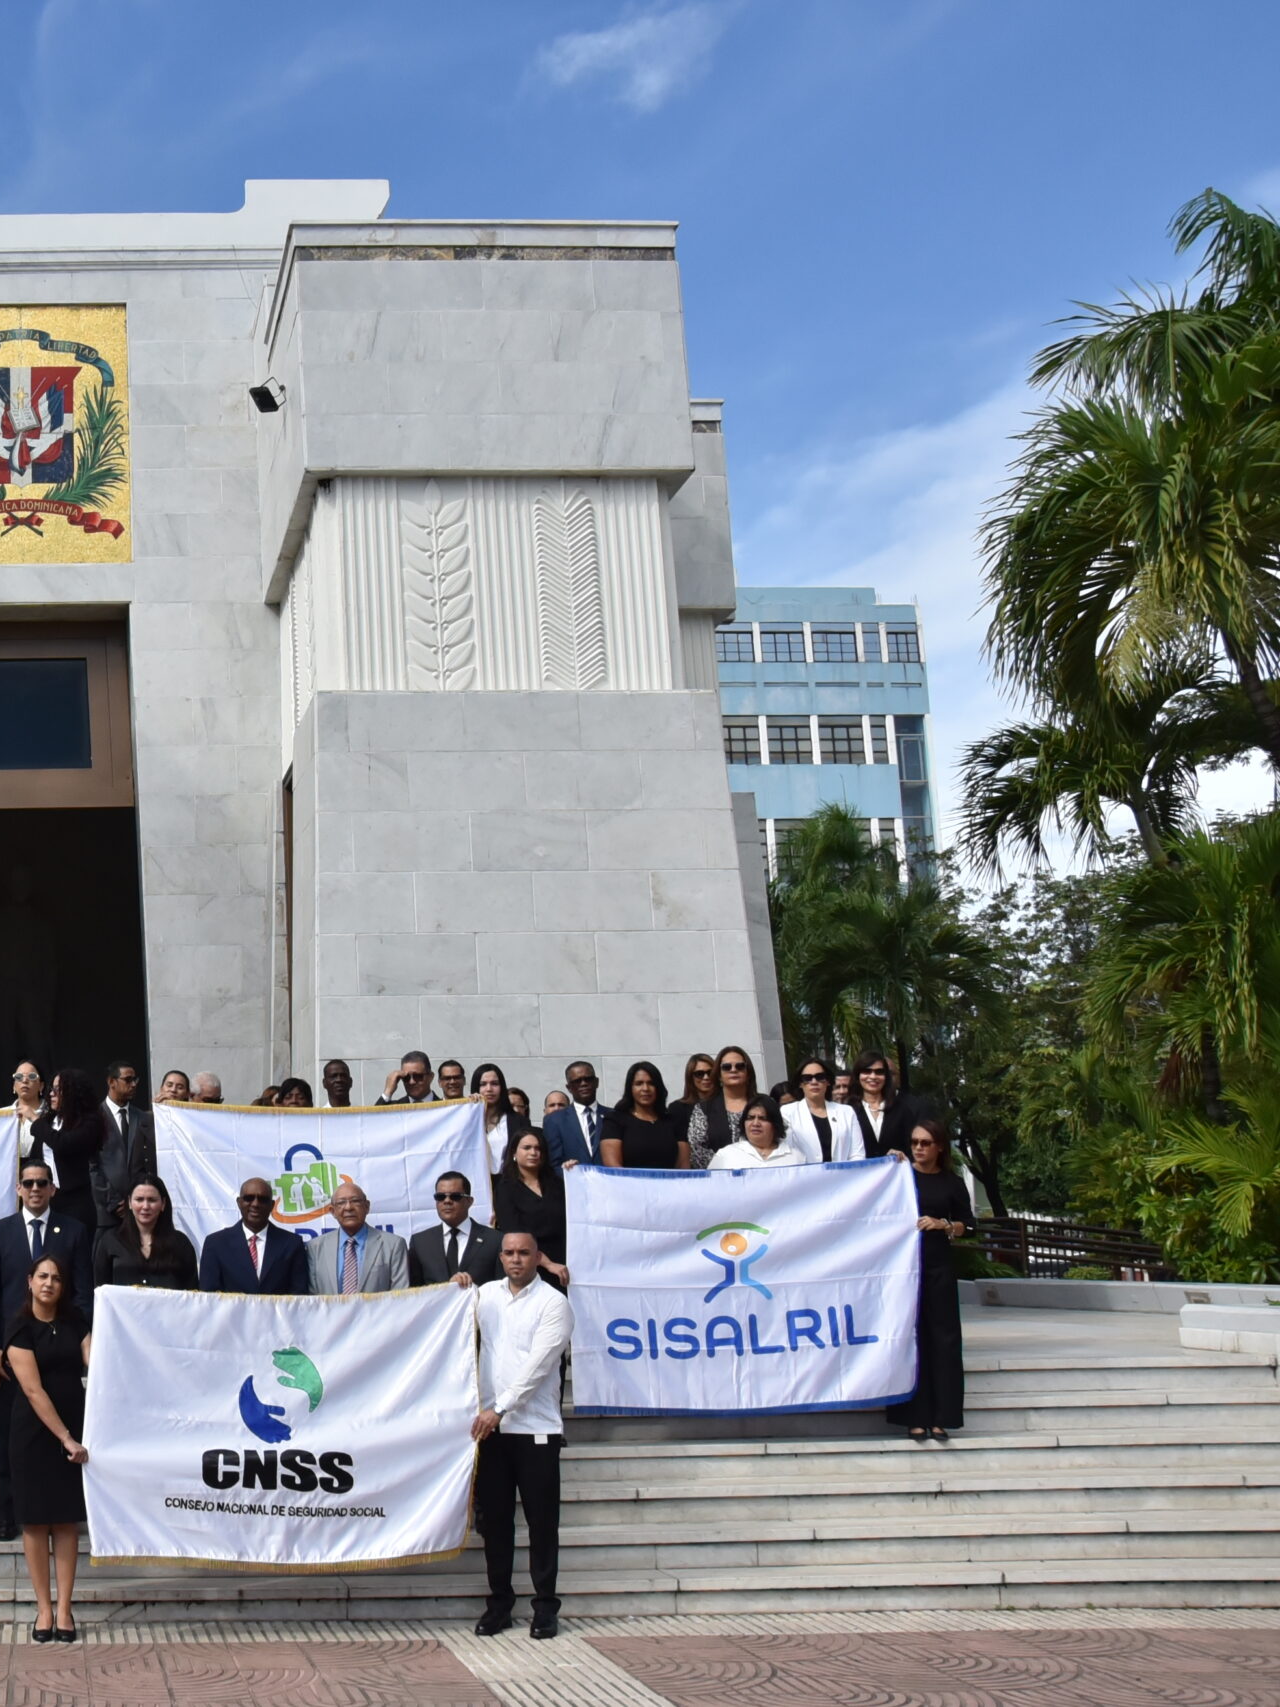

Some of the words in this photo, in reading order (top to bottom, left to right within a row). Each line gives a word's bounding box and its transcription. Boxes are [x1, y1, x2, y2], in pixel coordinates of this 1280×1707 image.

[47, 341, 98, 359] LIBERTAD
[20, 500, 79, 517] DOMINICANA
[606, 1304, 879, 1360] SISALRIL
[201, 1448, 355, 1494] CNSS
[165, 1497, 215, 1512] CONSEJO
[216, 1502, 269, 1516] NACIONAL
[271, 1504, 286, 1517] DE
[288, 1506, 348, 1518] SEGURIDAD
[350, 1507, 386, 1518] SOCIAL
